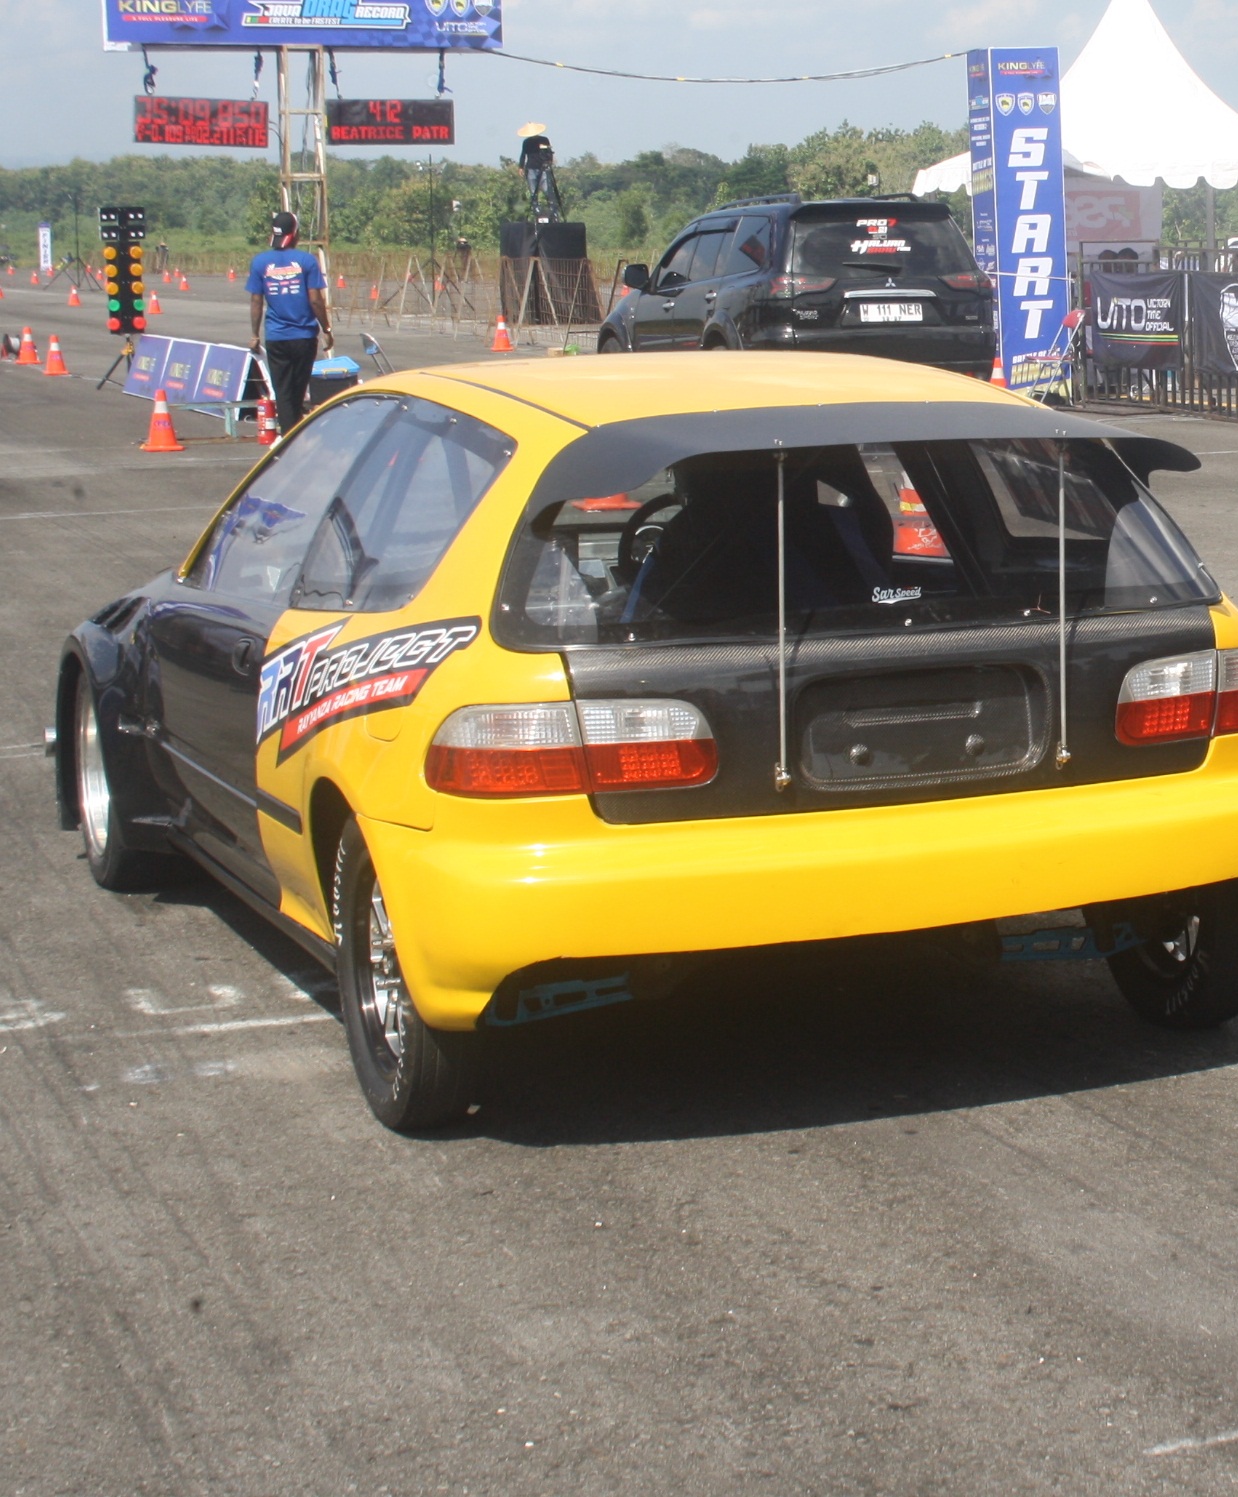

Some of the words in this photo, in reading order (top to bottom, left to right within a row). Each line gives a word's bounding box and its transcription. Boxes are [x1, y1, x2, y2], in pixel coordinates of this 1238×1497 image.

[265, 5, 301, 16] JAVA
[302, 0, 353, 18] DRAG
[355, 6, 405, 19] RECORD
[311, 17, 341, 25] FASTEST
[331, 126, 405, 140] BEATRICE
[412, 126, 449, 139] PATR
[1008, 128, 1053, 339] START
[862, 304, 869, 316] W
[876, 304, 892, 316] 111
[899, 303, 922, 315] NER
[371, 675, 408, 697] TEAM
